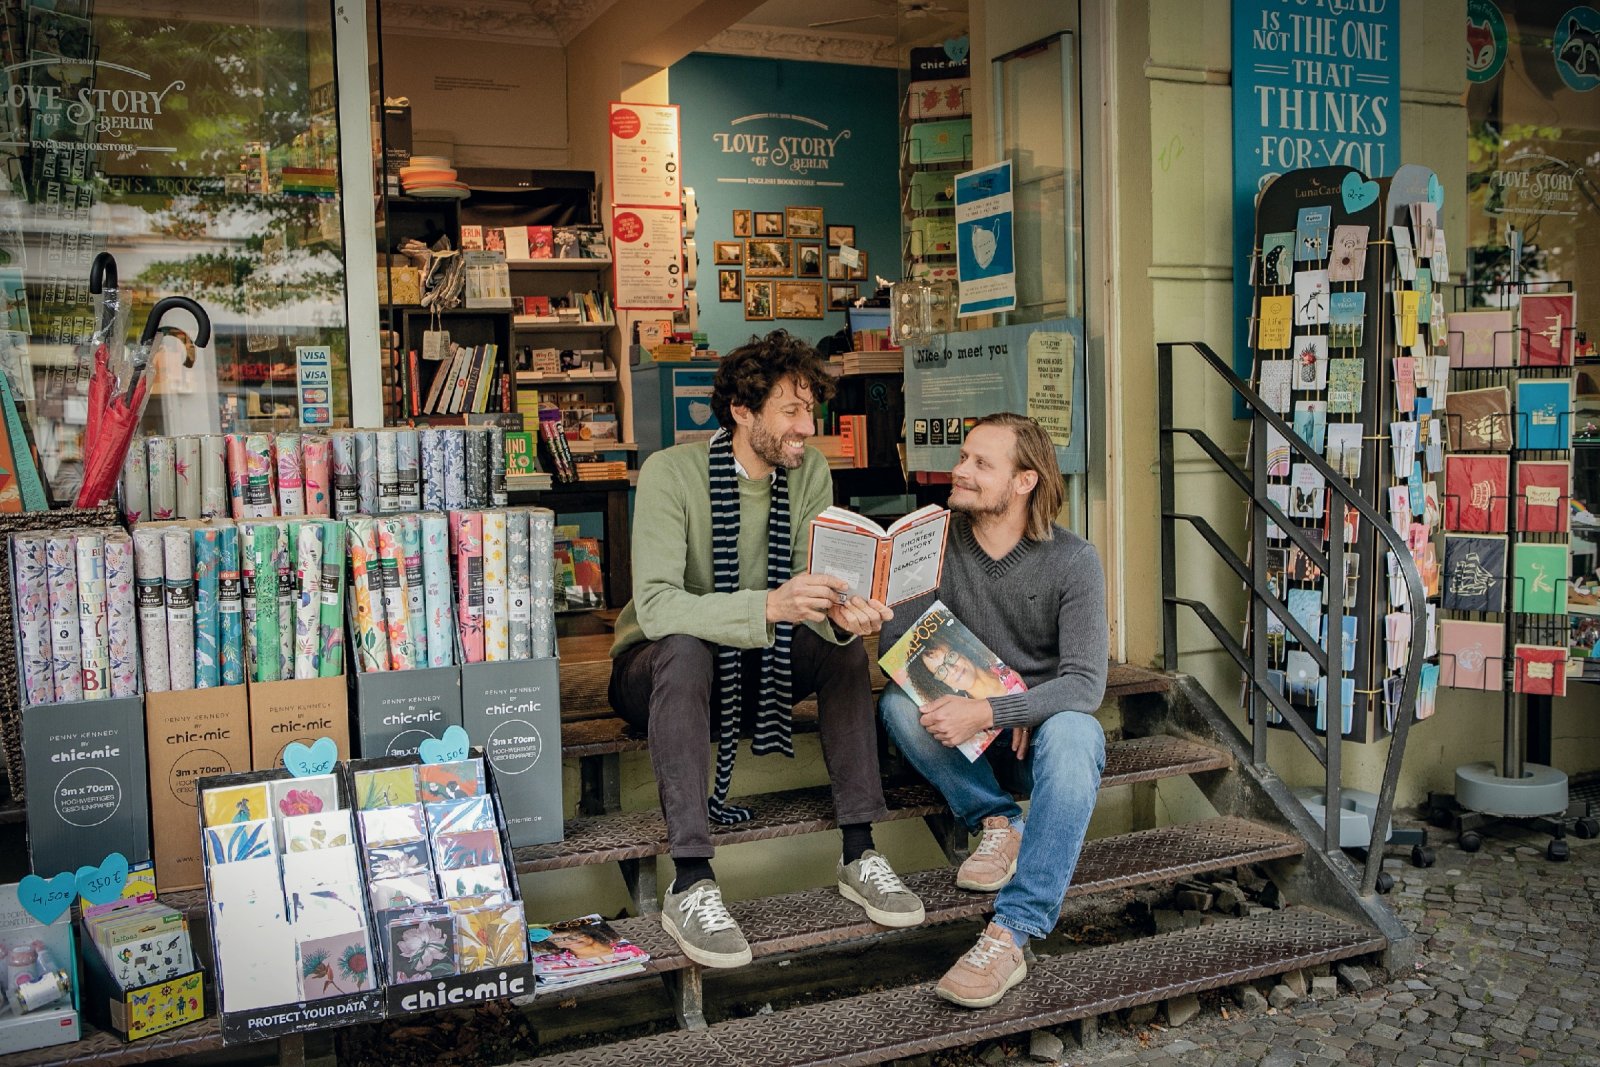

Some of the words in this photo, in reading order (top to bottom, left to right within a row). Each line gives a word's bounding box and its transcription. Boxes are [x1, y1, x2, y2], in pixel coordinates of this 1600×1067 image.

[1262, 10, 1280, 31] IS
[1253, 30, 1290, 51] NOT
[1289, 14, 1337, 56] THE
[1342, 20, 1388, 61] ONE
[1292, 59, 1354, 87] THAT
[67, 80, 185, 125] STORY
[1254, 85, 1388, 136] THINKS
[37, 113, 61, 126] OF
[95, 116, 153, 137] BERLIN
[76, 142, 133, 151] BOOKSTORE
[713, 133, 768, 153] LOVE
[771, 129, 851, 165] STORY
[1261, 136, 1312, 168] FOR
[1318, 139, 1385, 179] YOU
[752, 157, 768, 166] OF
[790, 158, 829, 174] BERLIN
[1498, 170, 1530, 187] LOVE
[1530, 168, 1584, 197] STORY
[957, 347, 983, 360] meet
[987, 344, 1008, 360] you
[305, 371, 326, 379] VISA
[894, 551, 937, 573] DEMOCRACY
[81, 729, 119, 738] KENNEDY
[493, 738, 506, 746] 3m
[513, 736, 536, 744] 70cm
[176, 769, 190, 777] 3m
[200, 766, 225, 774] 70cm
[61, 788, 77, 796] 3m
[86, 784, 114, 793] 70cm
[248, 1012, 301, 1028] PROTECT
[302, 1006, 336, 1020] YOUR
[336, 1000, 367, 1015] DATA
